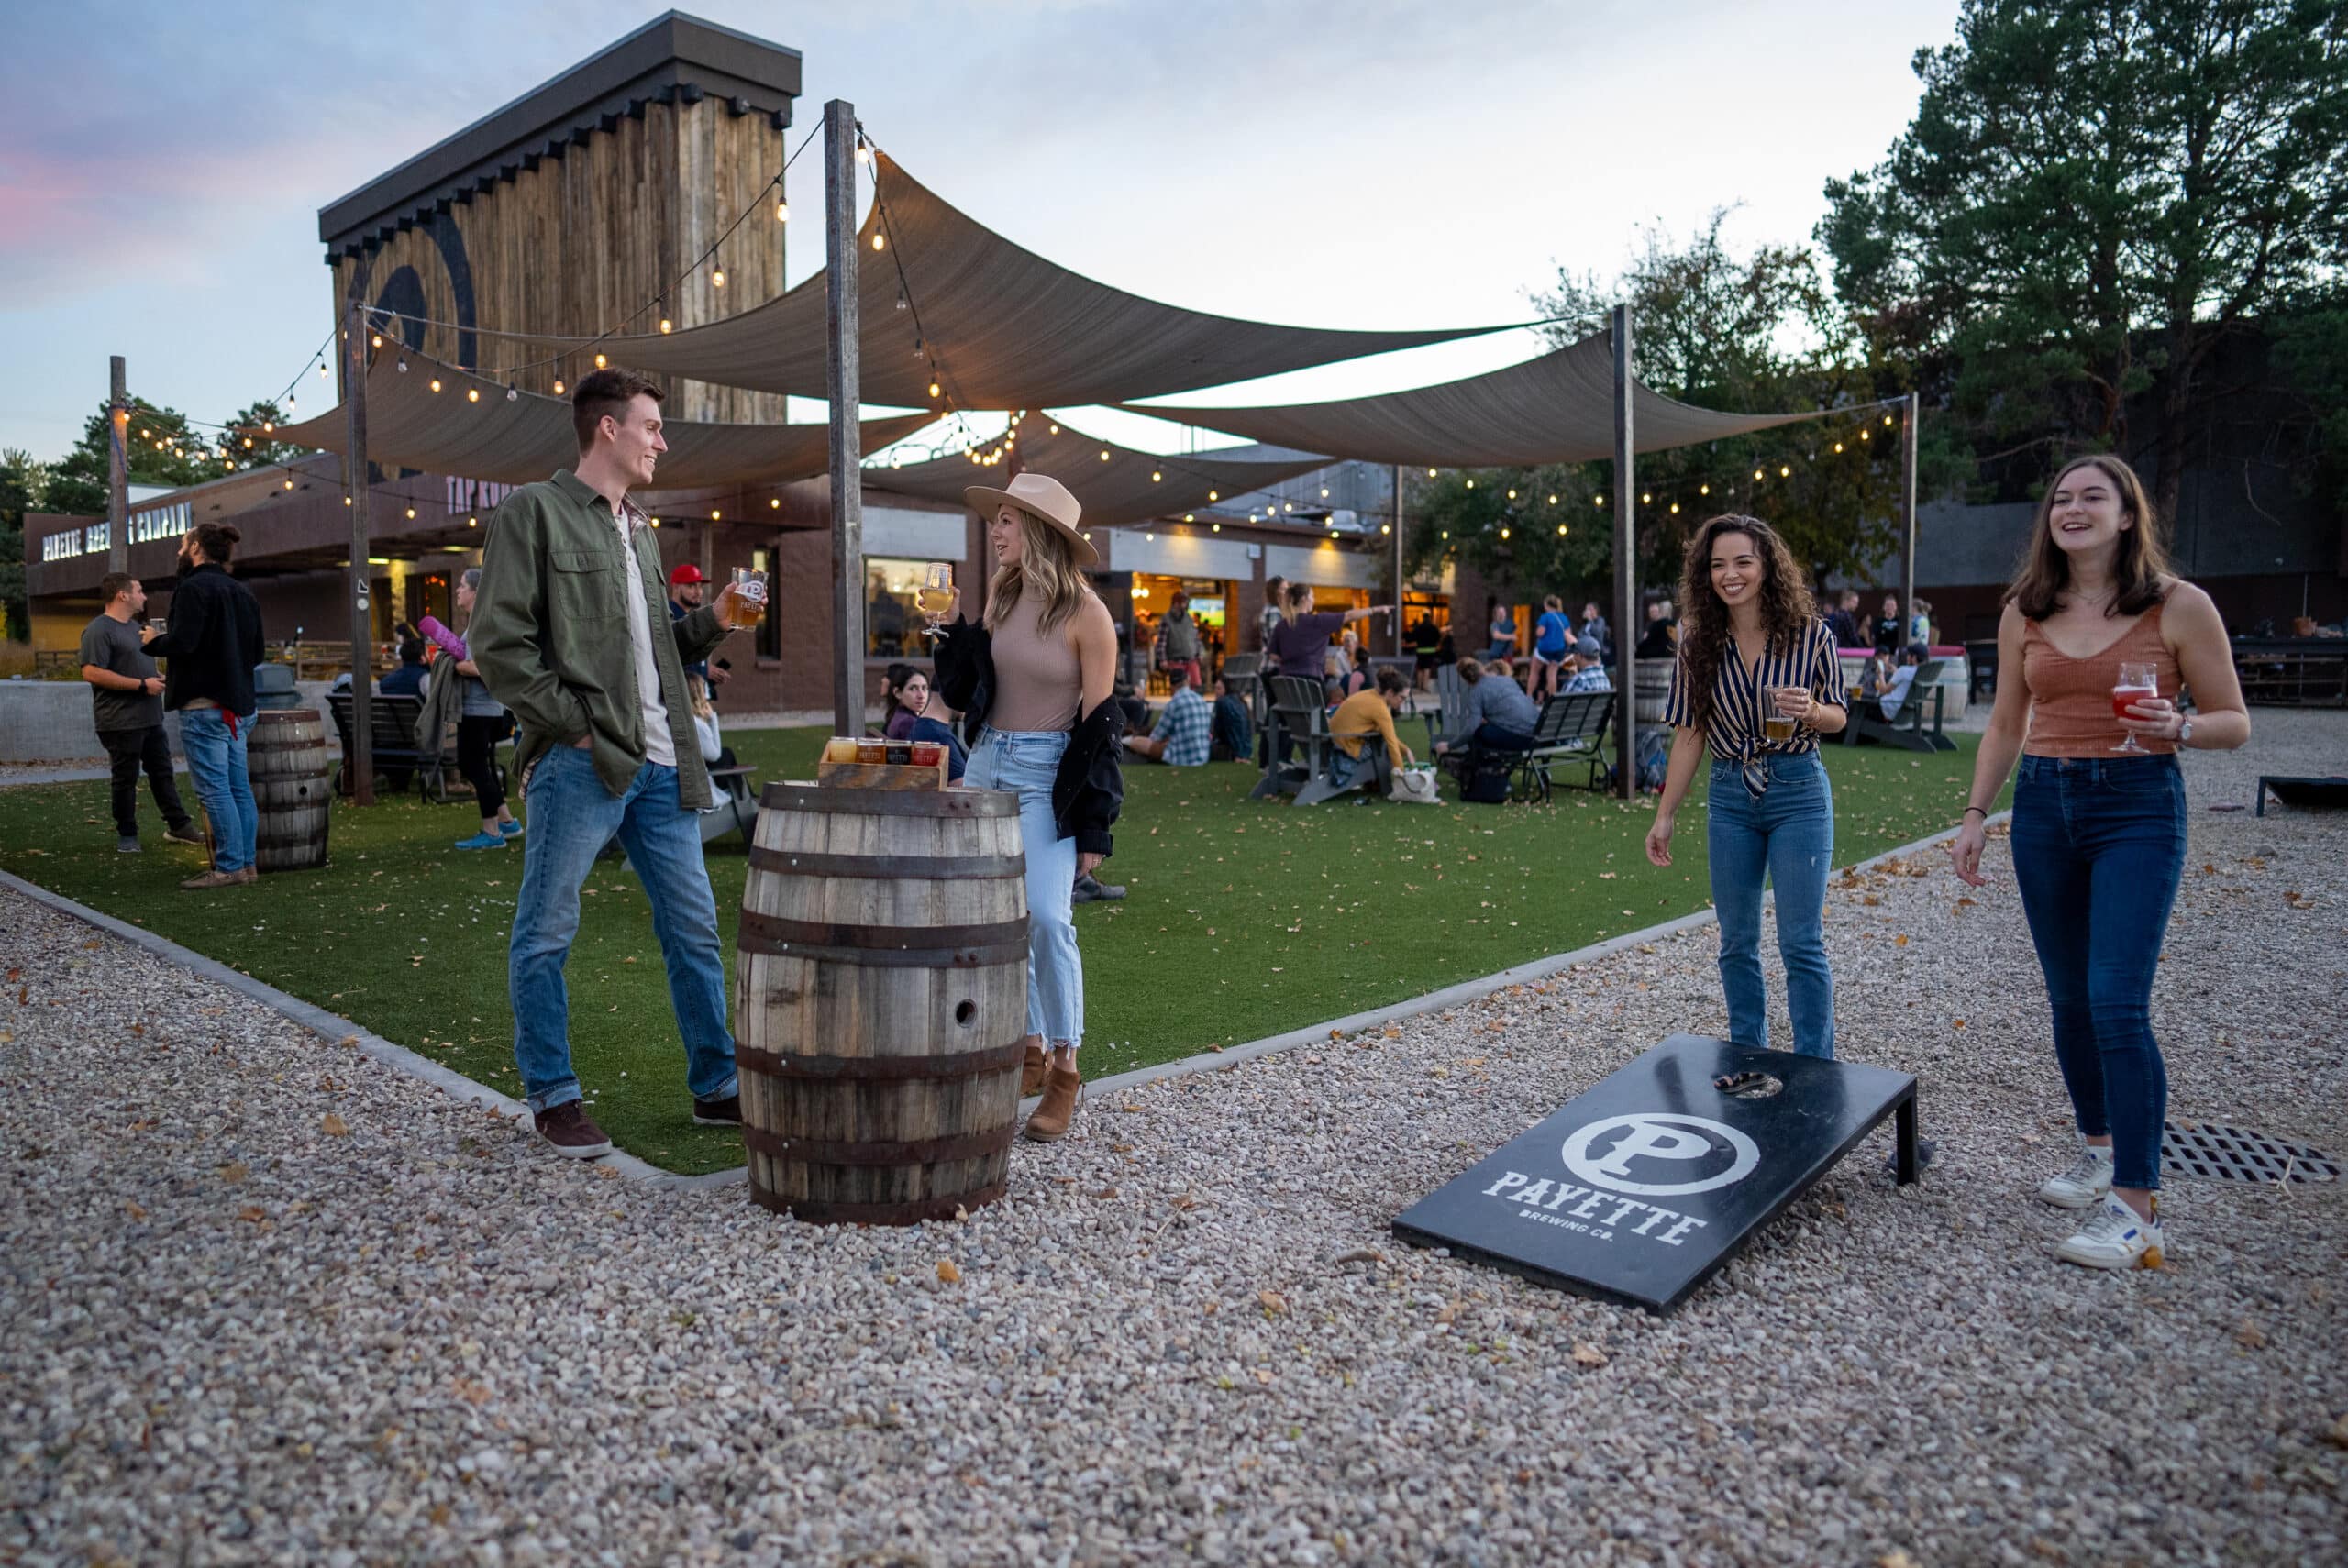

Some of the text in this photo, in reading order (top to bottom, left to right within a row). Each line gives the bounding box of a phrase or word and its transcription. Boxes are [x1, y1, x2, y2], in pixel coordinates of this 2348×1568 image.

[446, 476, 524, 514] TAP ROO
[1481, 1171, 1708, 1246] PAYETTE
[1519, 1209, 1614, 1242] BREWING CO.
